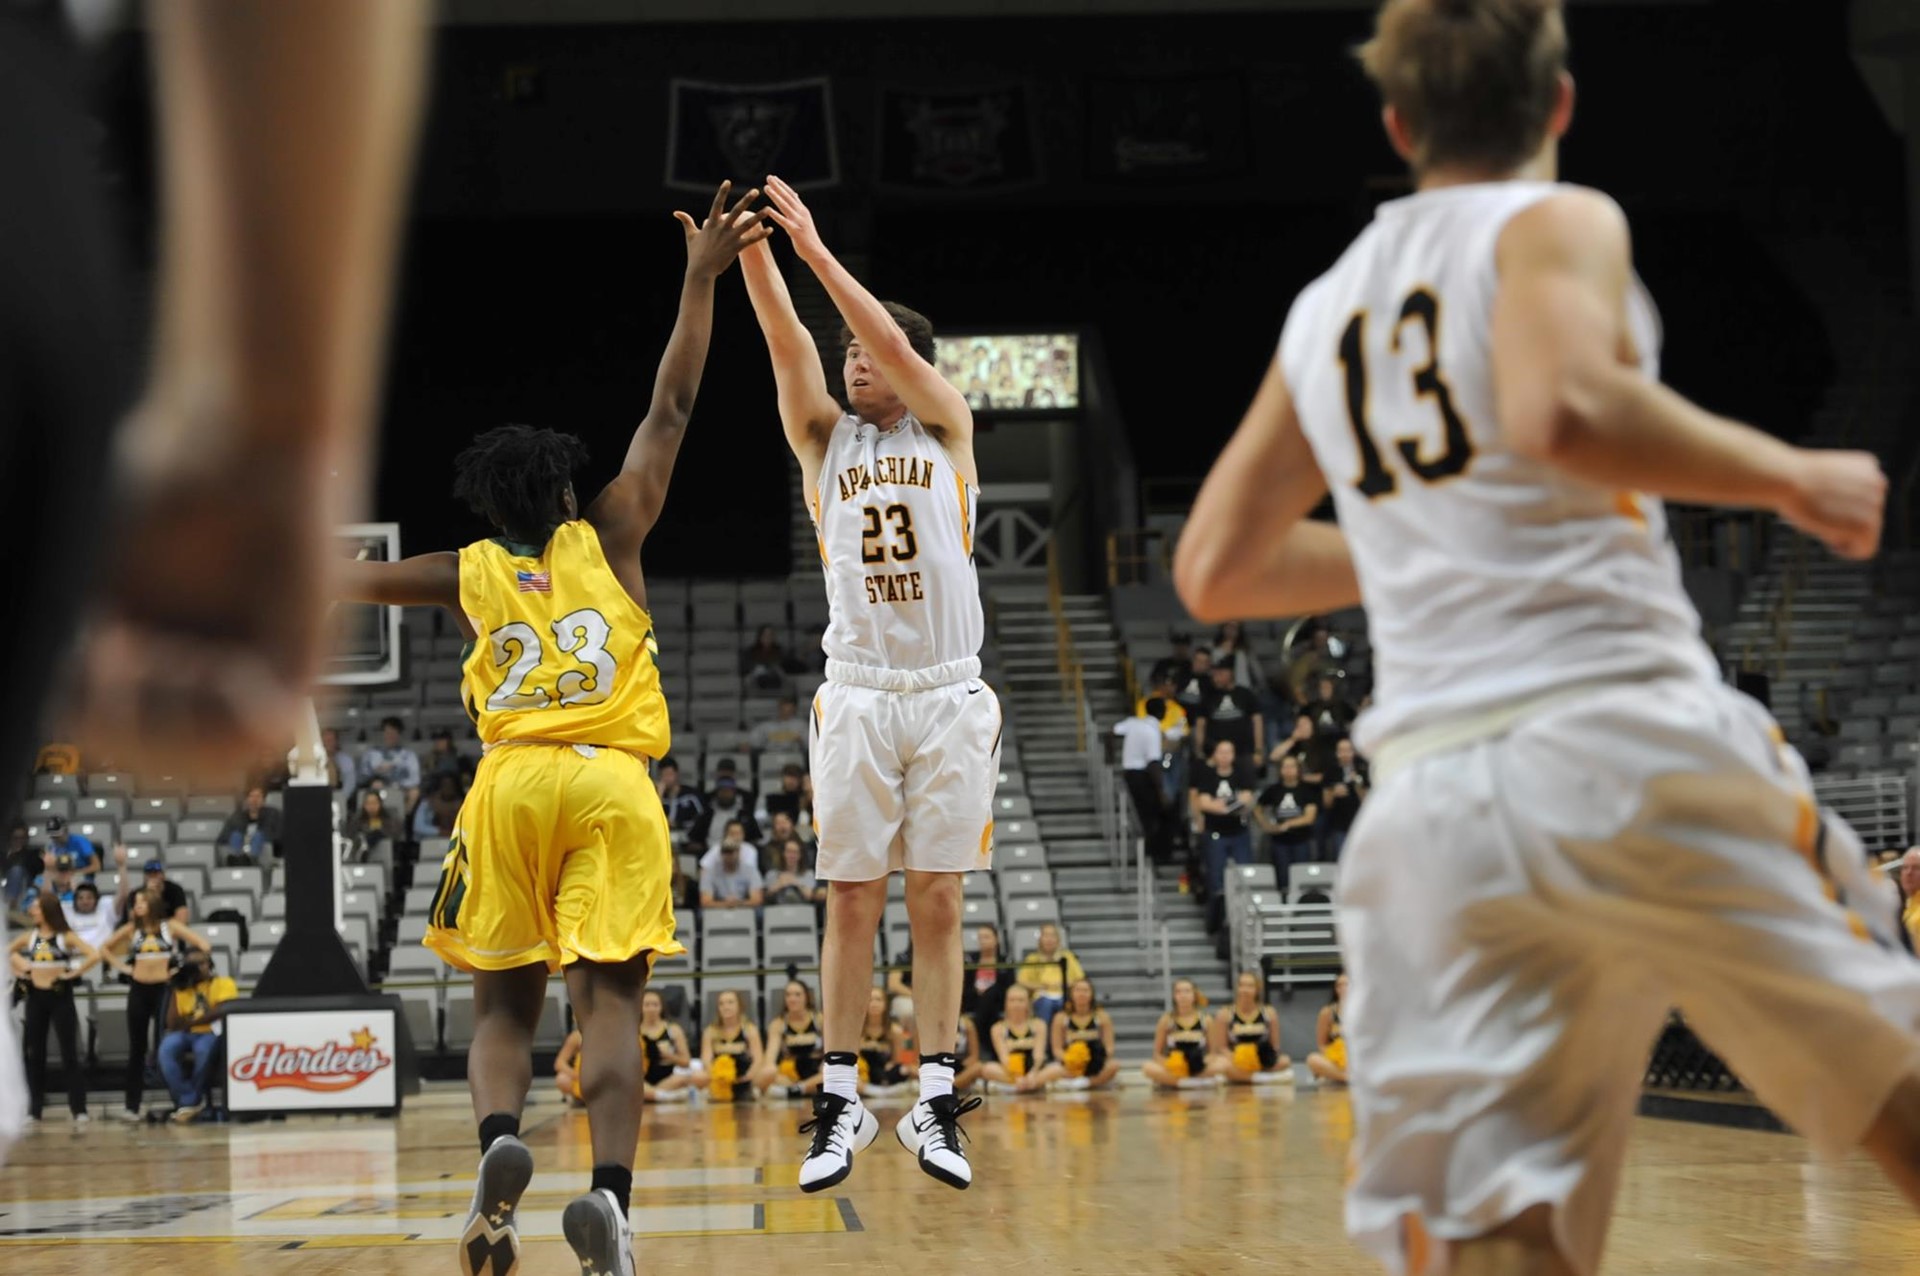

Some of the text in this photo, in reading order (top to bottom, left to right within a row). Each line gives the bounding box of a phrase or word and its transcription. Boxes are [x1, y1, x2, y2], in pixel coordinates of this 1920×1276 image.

[1336, 285, 1477, 499] 13
[861, 503, 918, 564] 23
[865, 571, 923, 603] STATE
[486, 608, 617, 711] 23
